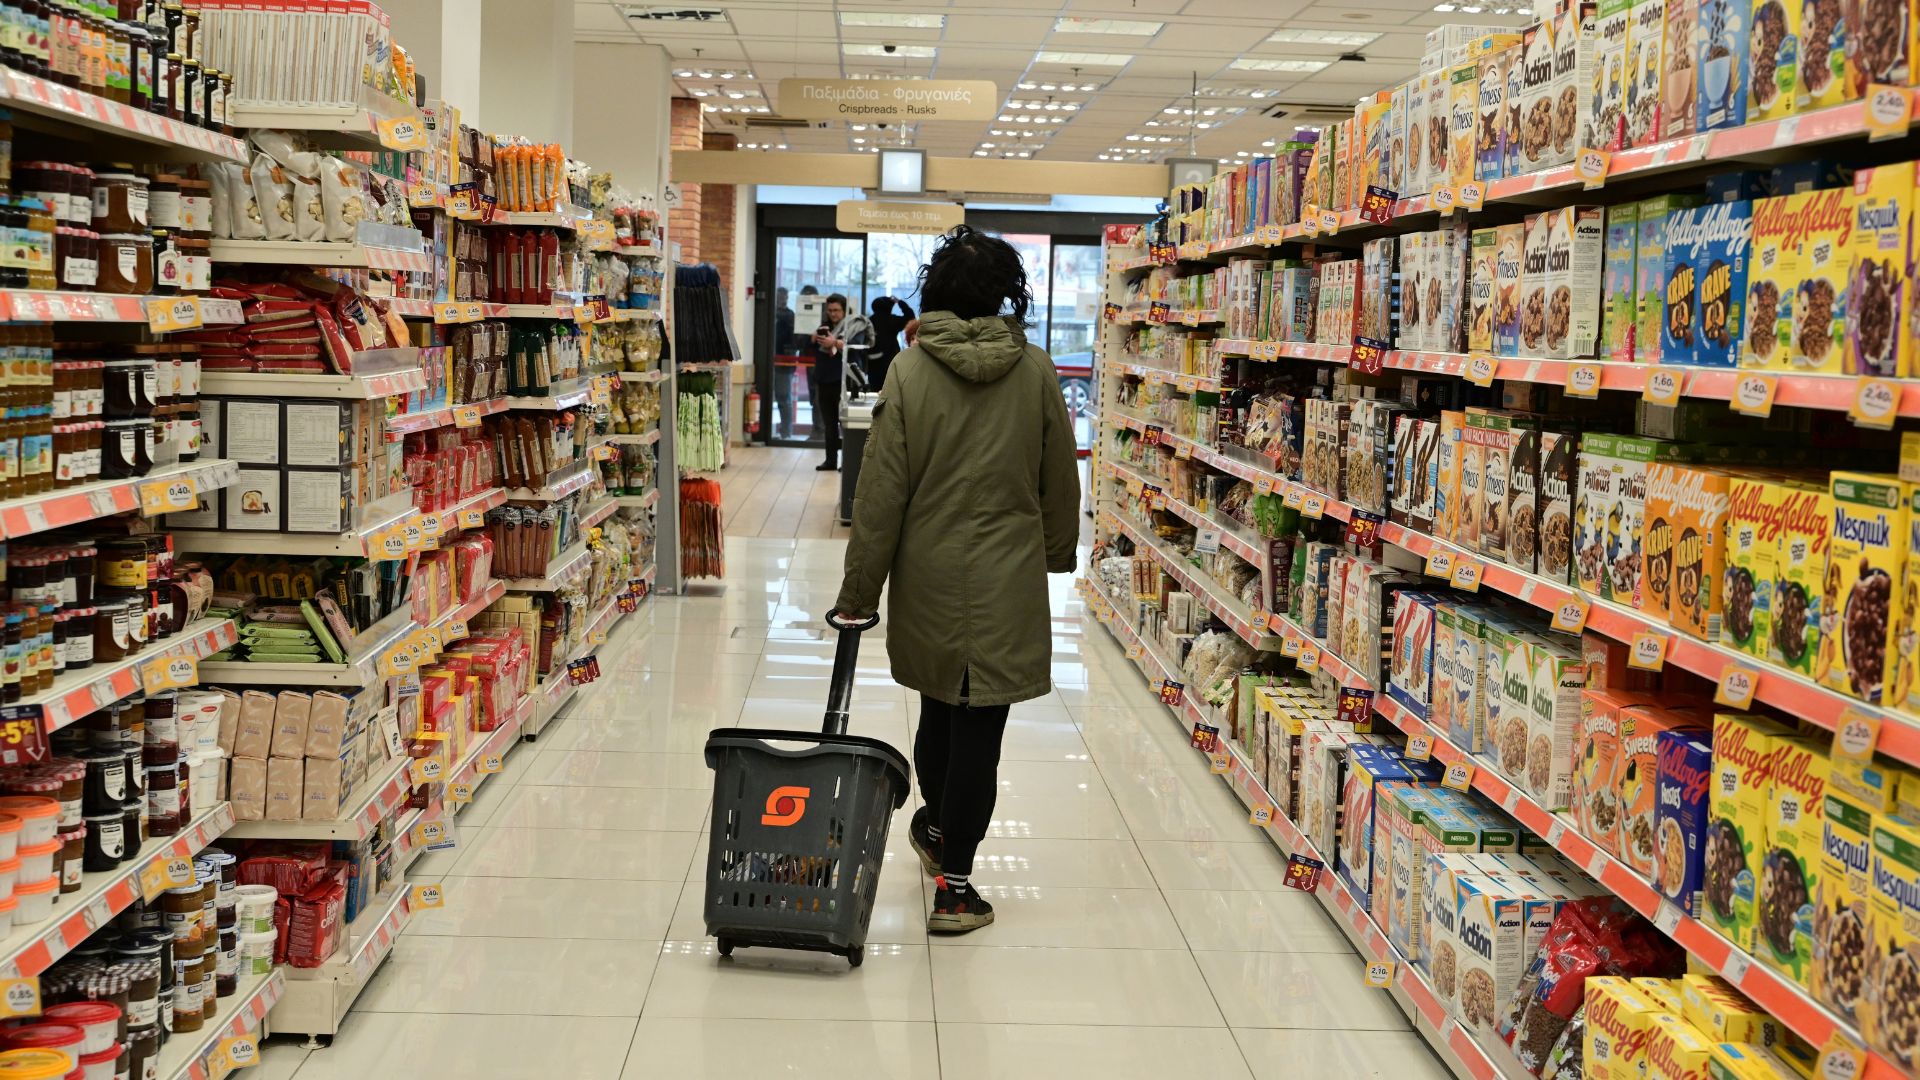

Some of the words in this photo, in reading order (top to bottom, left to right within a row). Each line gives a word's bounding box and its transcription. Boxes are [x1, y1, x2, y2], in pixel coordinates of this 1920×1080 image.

[1604, 17, 1626, 41] alpha
[1640, 4, 1663, 29] alpha
[1523, 56, 1551, 90] Action
[1554, 45, 1576, 79] Action
[802, 85, 879, 102] Παξιμάδια
[893, 86, 972, 103] Φρυγανιές
[839, 103, 898, 115] Crispbreads
[907, 105, 937, 115] Rusks
[1368, 195, 1388, 208] -5%
[1577, 225, 1600, 235] Action
[1858, 199, 1900, 238] Nesquik
[1665, 207, 1701, 260] Kellog
[1546, 245, 1569, 274] Action
[1667, 267, 1695, 305] KRAVE
[1701, 264, 1731, 304] KRAVE
[1355, 345, 1376, 359] -5%
[1510, 466, 1535, 495] Action
[1585, 470, 1610, 493] Pillows
[1596, 465, 1611, 481] Crispy
[1542, 472, 1569, 502] Action
[1645, 464, 1680, 516] Kellog
[1352, 517, 1373, 532] -5%
[1834, 507, 1890, 552] Nesquik
[1647, 524, 1673, 556] KRAVE
[1677, 534, 1703, 569] KRAVE
[1503, 671, 1528, 705] Action
[1560, 680, 1586, 689] Action
[1343, 697, 1364, 709] -5%
[1532, 687, 1553, 722] Action
[0, 719, 35, 744] -5%
[1584, 713, 1617, 737] Sweetos
[1290, 864, 1312, 877] -5%
[1433, 890, 1454, 933] Action
[1499, 919, 1521, 928] Action
[1530, 920, 1552, 928] Action
[1459, 916, 1492, 961] Action
